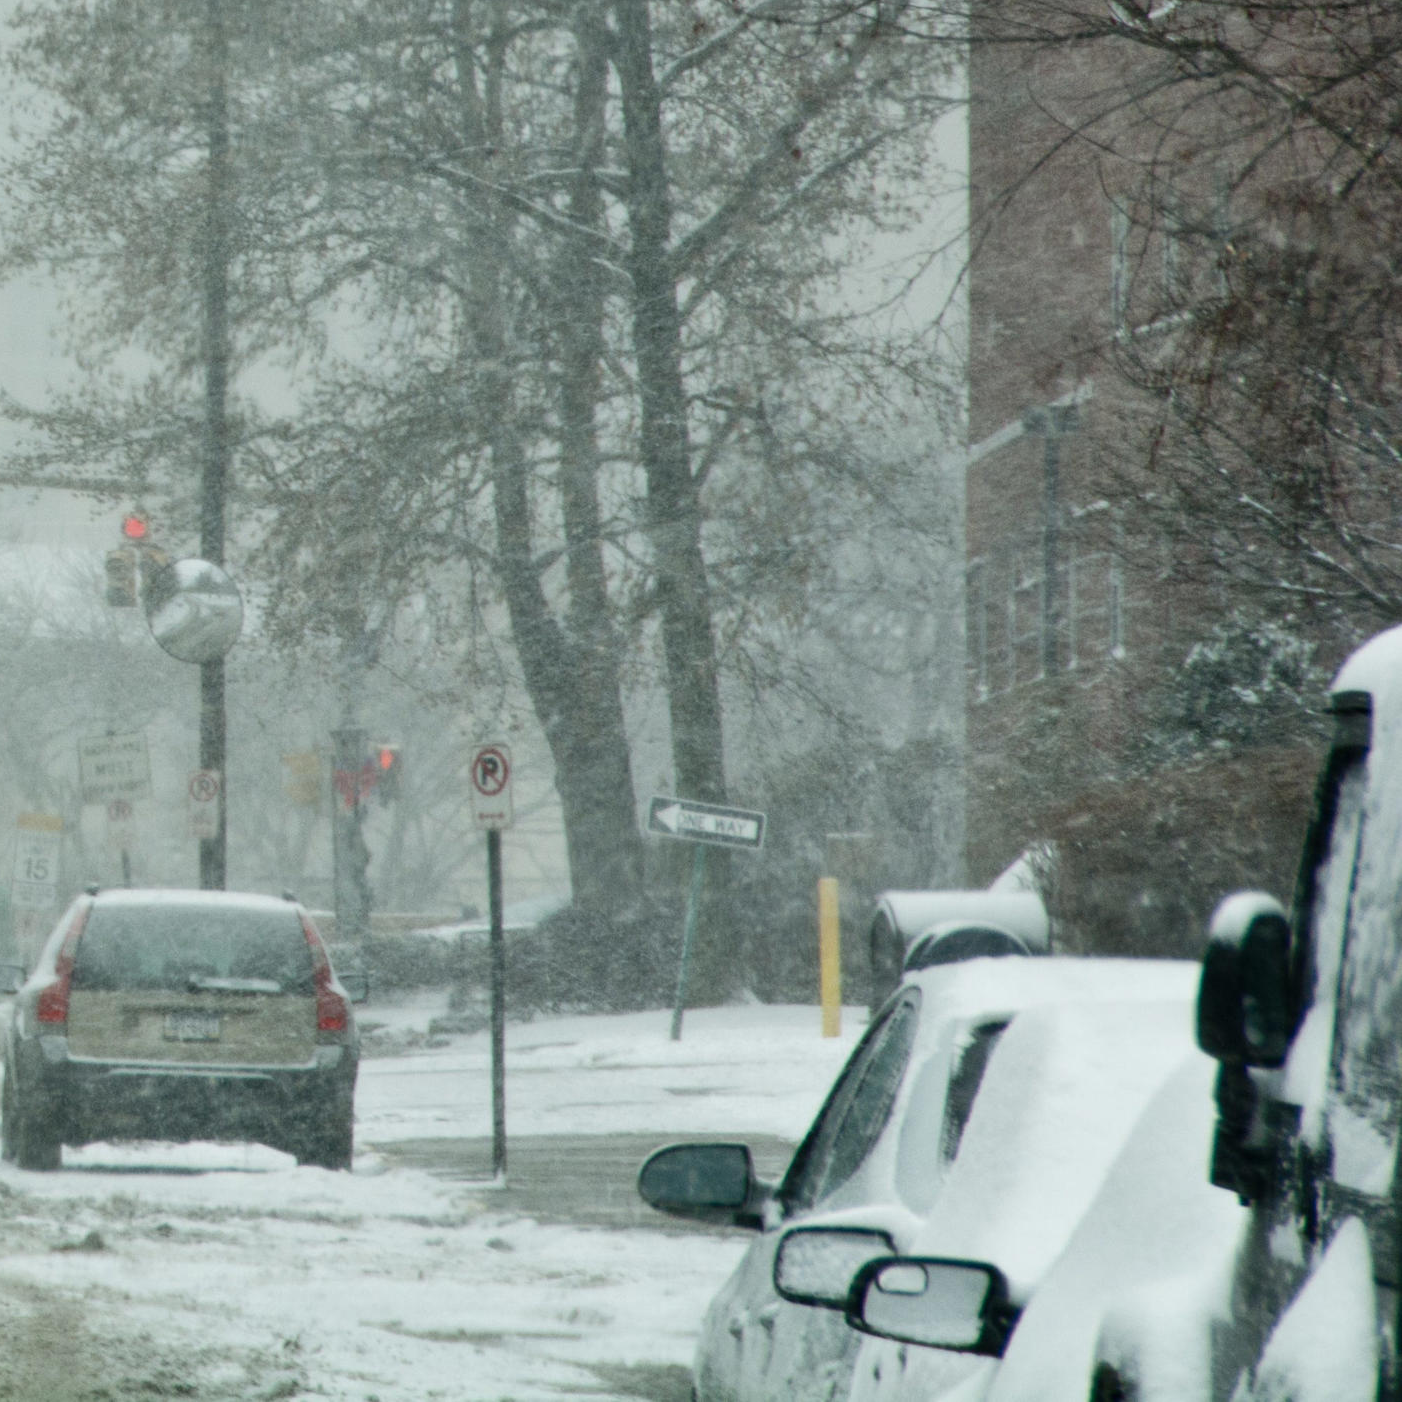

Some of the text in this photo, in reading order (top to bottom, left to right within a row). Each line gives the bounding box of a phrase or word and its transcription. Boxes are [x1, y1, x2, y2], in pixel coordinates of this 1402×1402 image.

[677, 811, 748, 836] ONE WAY
[23, 857, 49, 881] 15
